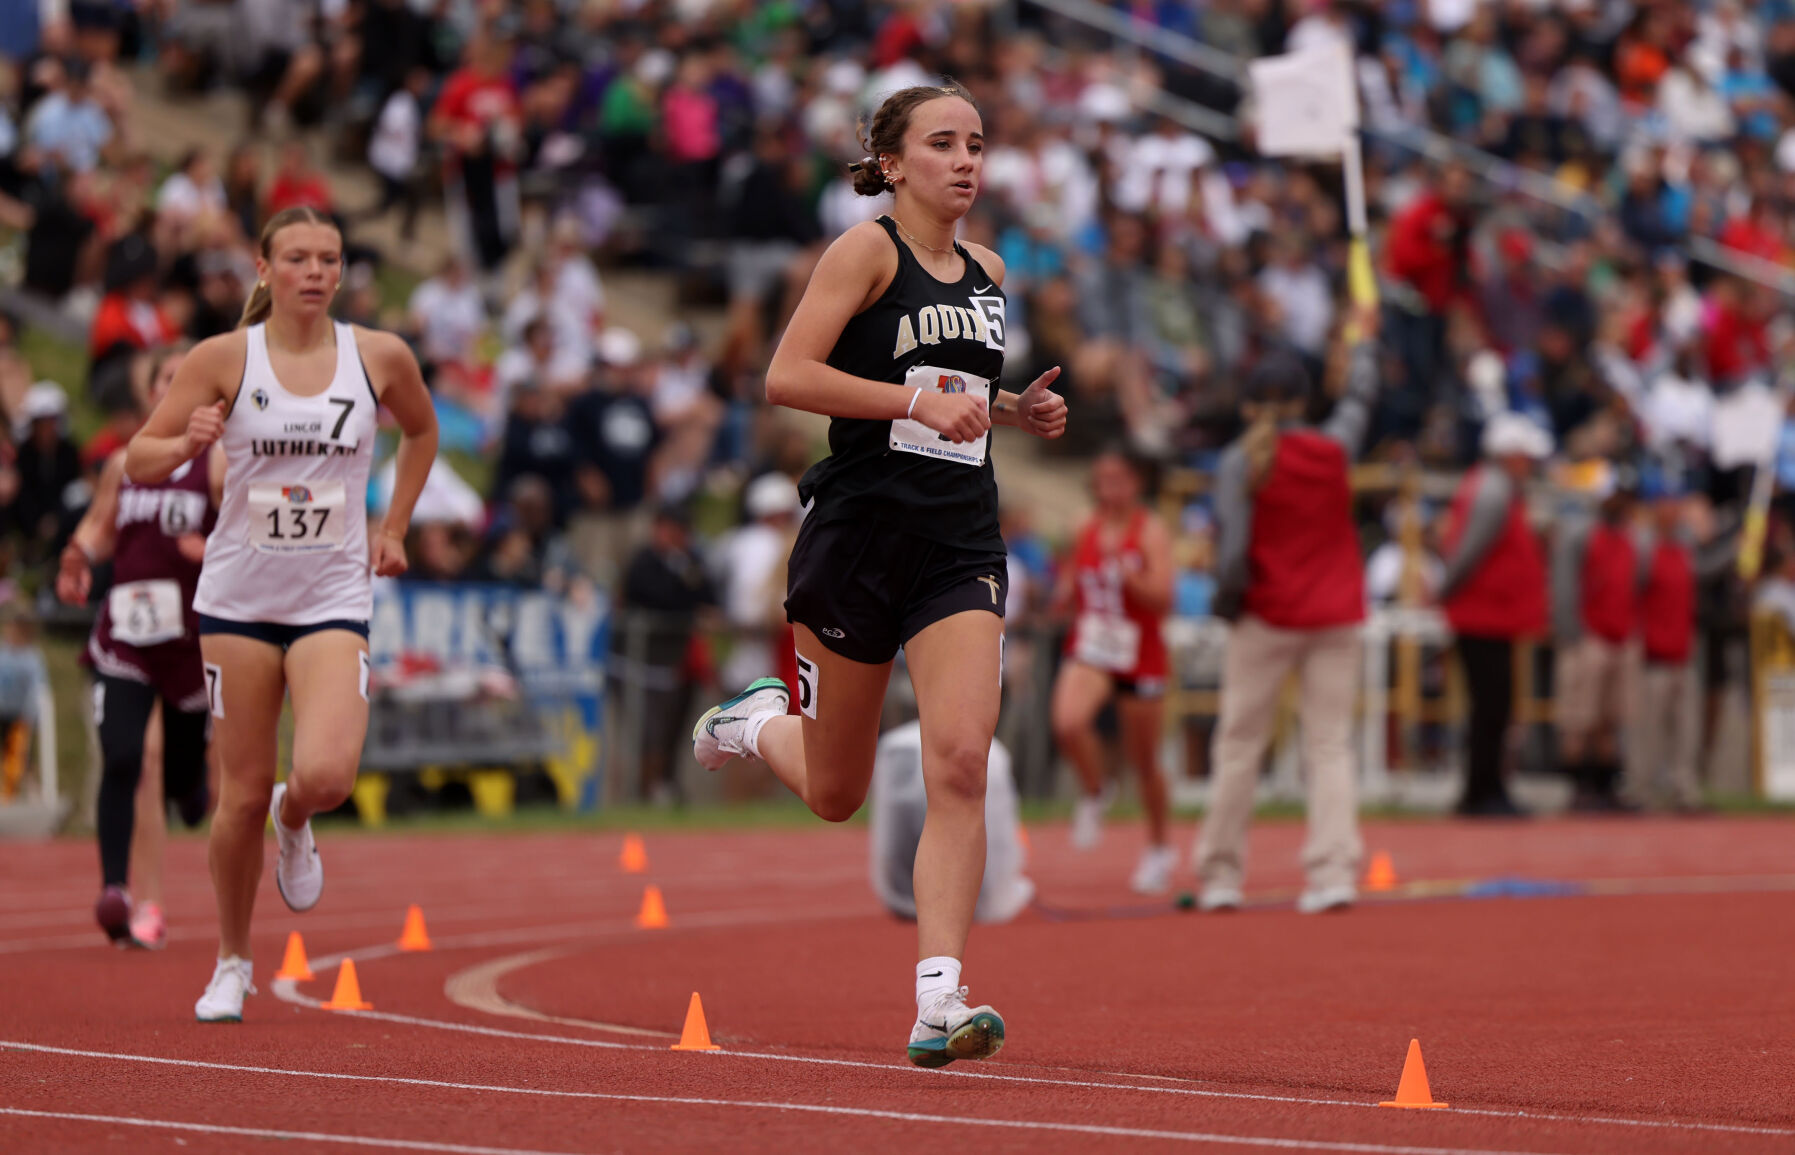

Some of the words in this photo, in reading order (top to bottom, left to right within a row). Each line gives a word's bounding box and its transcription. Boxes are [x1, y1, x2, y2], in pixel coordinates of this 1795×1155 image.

[977, 299, 1005, 347] 5
[329, 397, 355, 440] 7
[901, 442, 919, 451] TRACK
[926, 446, 942, 455] FIELD
[943, 450, 978, 462] CHAMPIONSHIPS
[267, 507, 331, 539] 137
[206, 669, 217, 711] 7
[797, 655, 811, 709] 5
